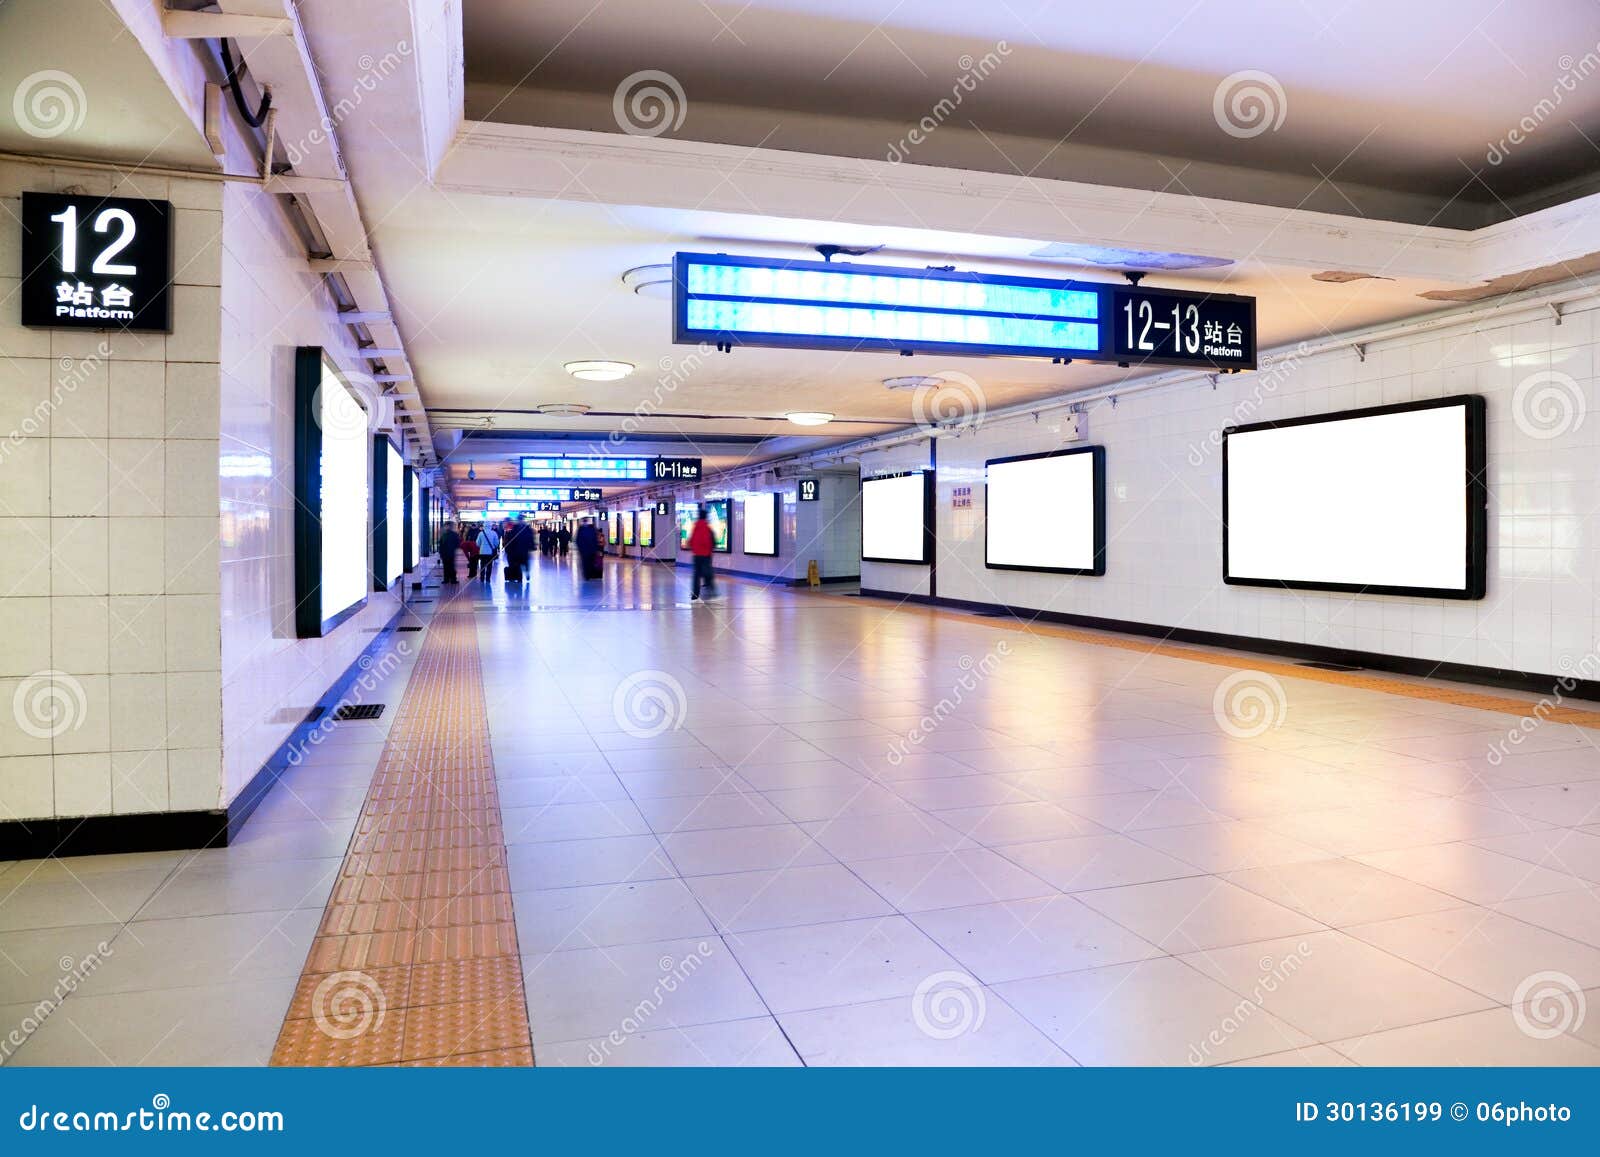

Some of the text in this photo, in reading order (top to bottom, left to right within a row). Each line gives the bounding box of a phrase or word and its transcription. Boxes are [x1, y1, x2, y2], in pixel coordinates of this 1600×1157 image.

[51, 205, 137, 276] 12
[56, 281, 134, 307] 站台
[56, 306, 134, 319] Platform
[1124, 299, 1200, 354] 12-13
[1204, 320, 1243, 346] 站台
[1204, 345, 1243, 358] Platform
[654, 462, 681, 478] 10-11
[574, 490, 590, 500] 8-9
[802, 481, 815, 493] 10
